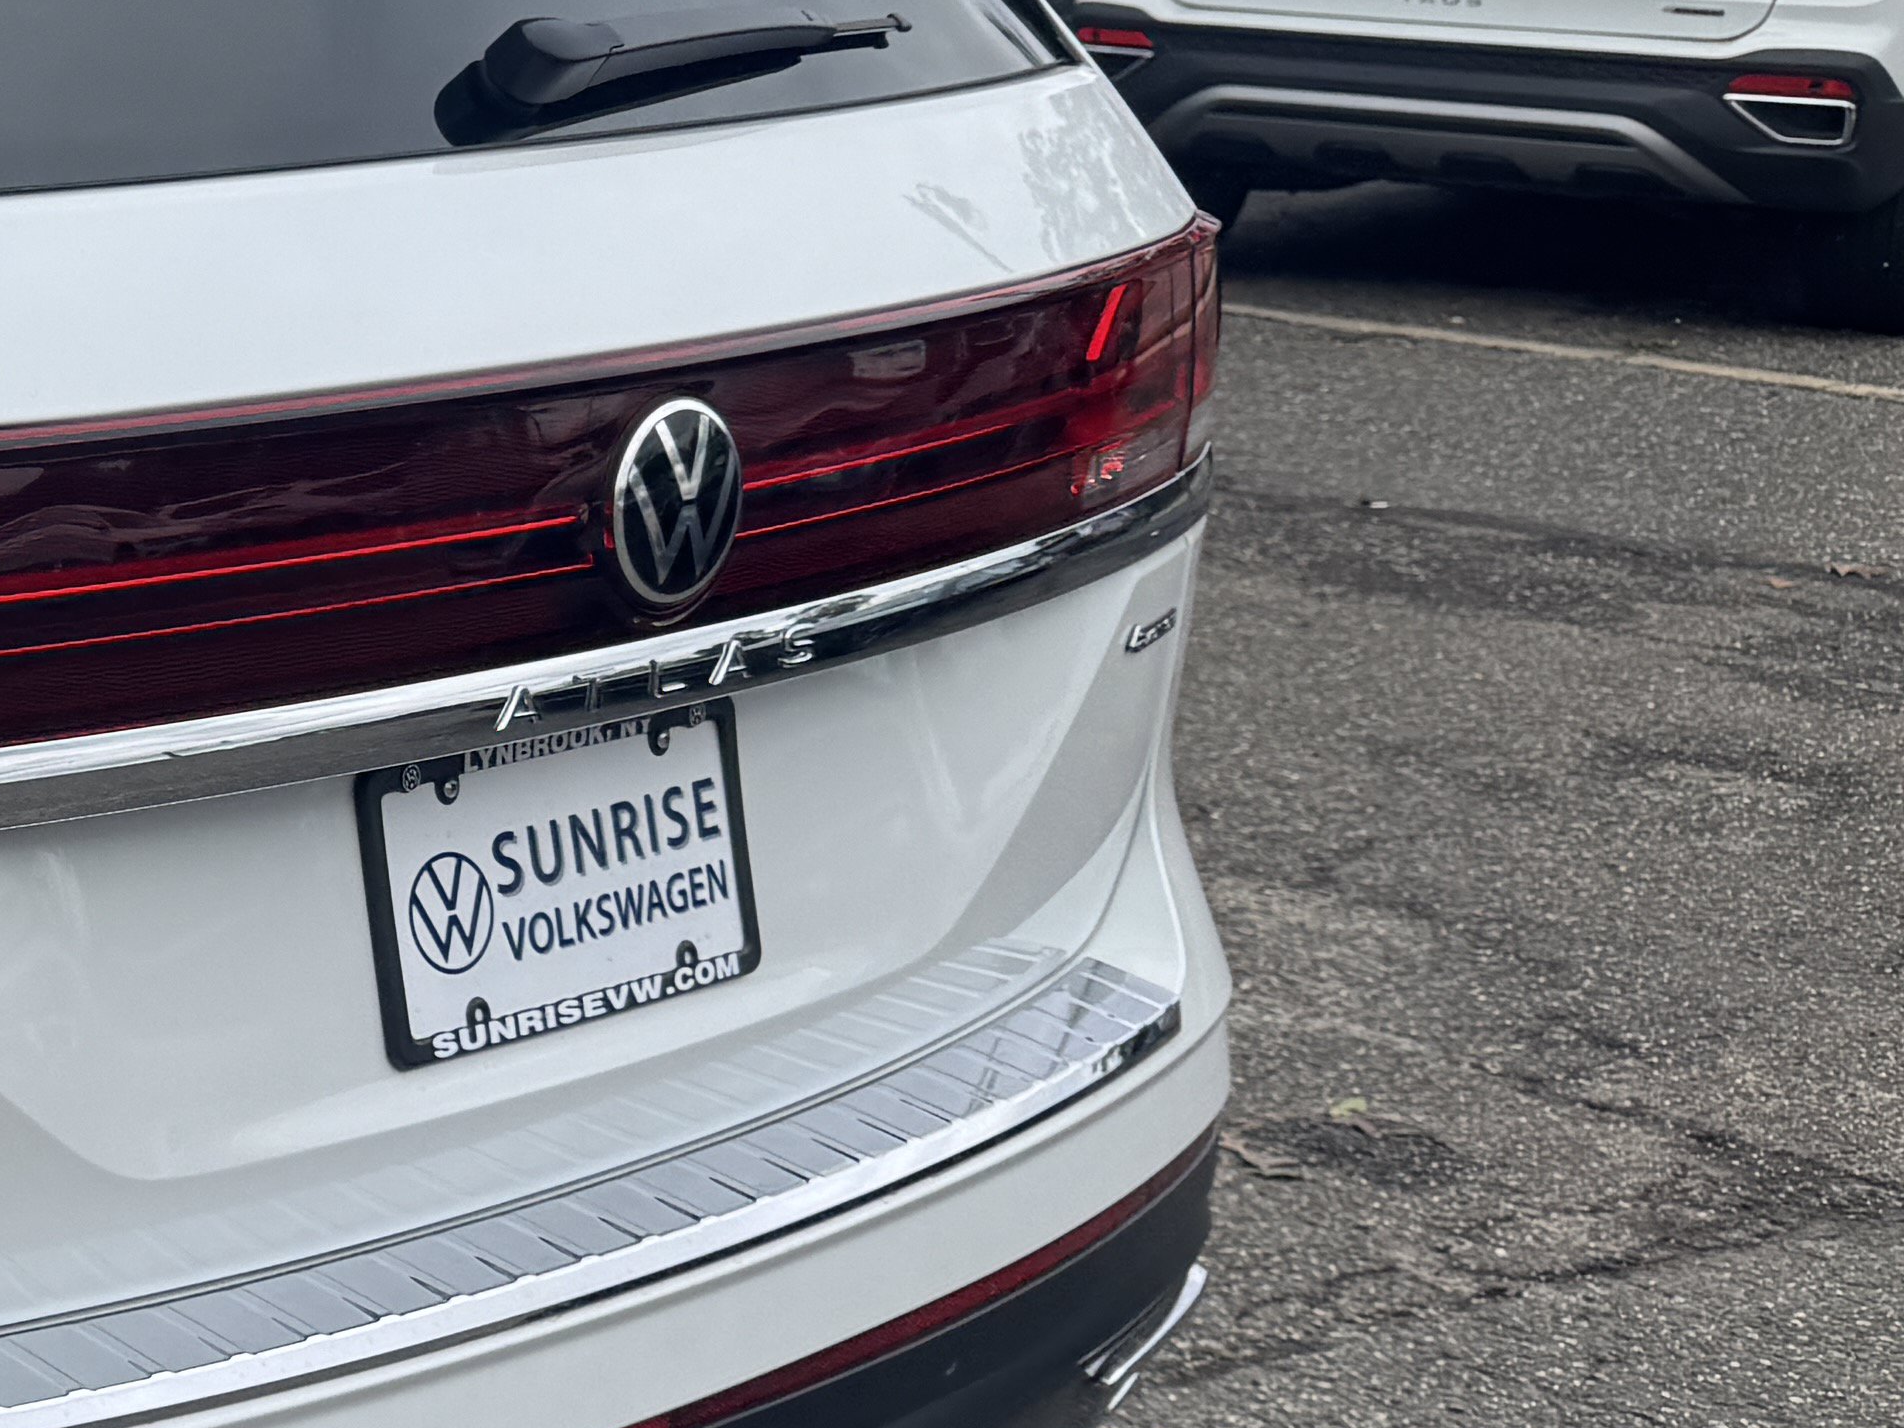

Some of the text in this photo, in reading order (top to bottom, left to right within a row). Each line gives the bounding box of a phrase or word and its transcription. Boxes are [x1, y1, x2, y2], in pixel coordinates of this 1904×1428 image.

[494, 622, 816, 731] ATLAS
[491, 777, 723, 898] SUNRISE
[502, 859, 730, 961] VOLKSWAGEN
[432, 952, 741, 1059] SUNRISEVW.COM
